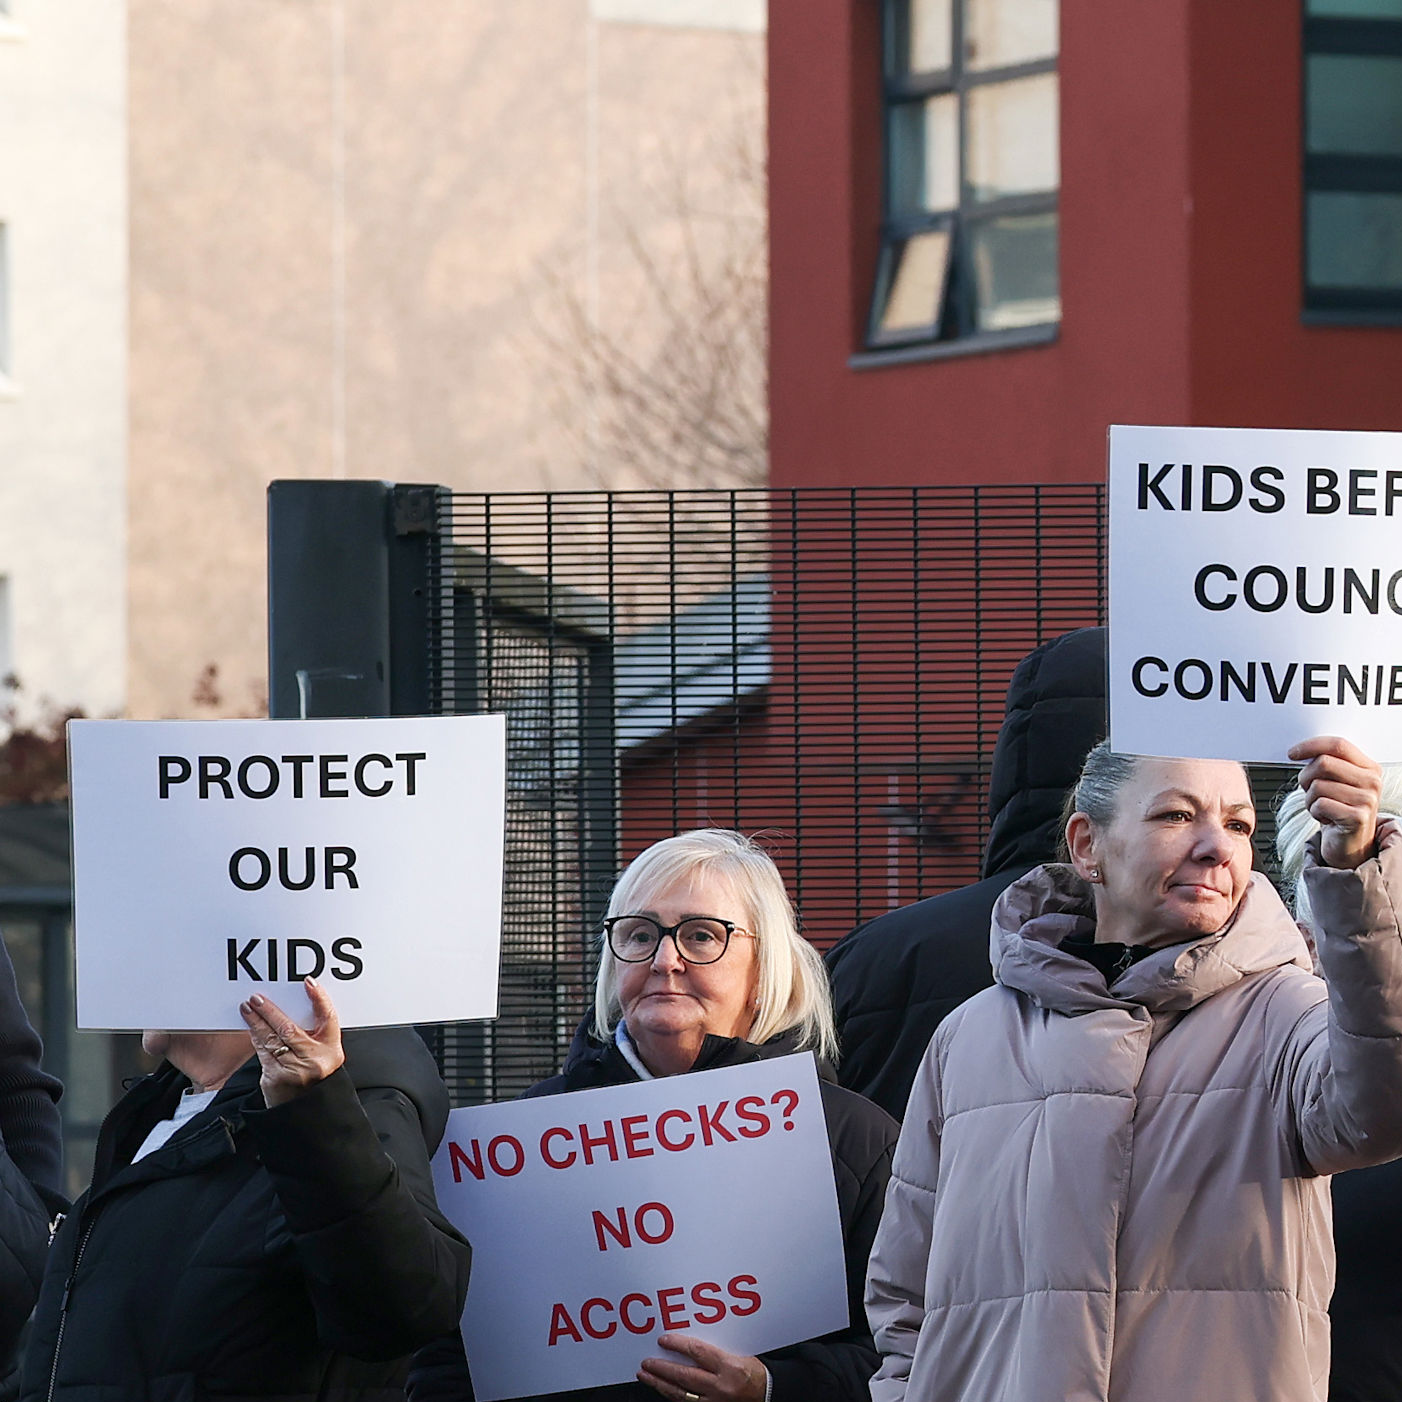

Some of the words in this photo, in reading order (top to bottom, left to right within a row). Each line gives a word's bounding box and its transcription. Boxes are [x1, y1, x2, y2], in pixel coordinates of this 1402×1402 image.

[1138, 463, 1285, 513] KIDS
[159, 753, 426, 799] PROTECT
[229, 847, 359, 891] OUR
[227, 937, 363, 982] KIDS
[448, 1134, 525, 1183] NO
[540, 1090, 799, 1169] CHECKS?
[592, 1202, 674, 1252] NO
[547, 1275, 761, 1347] ACCESS
